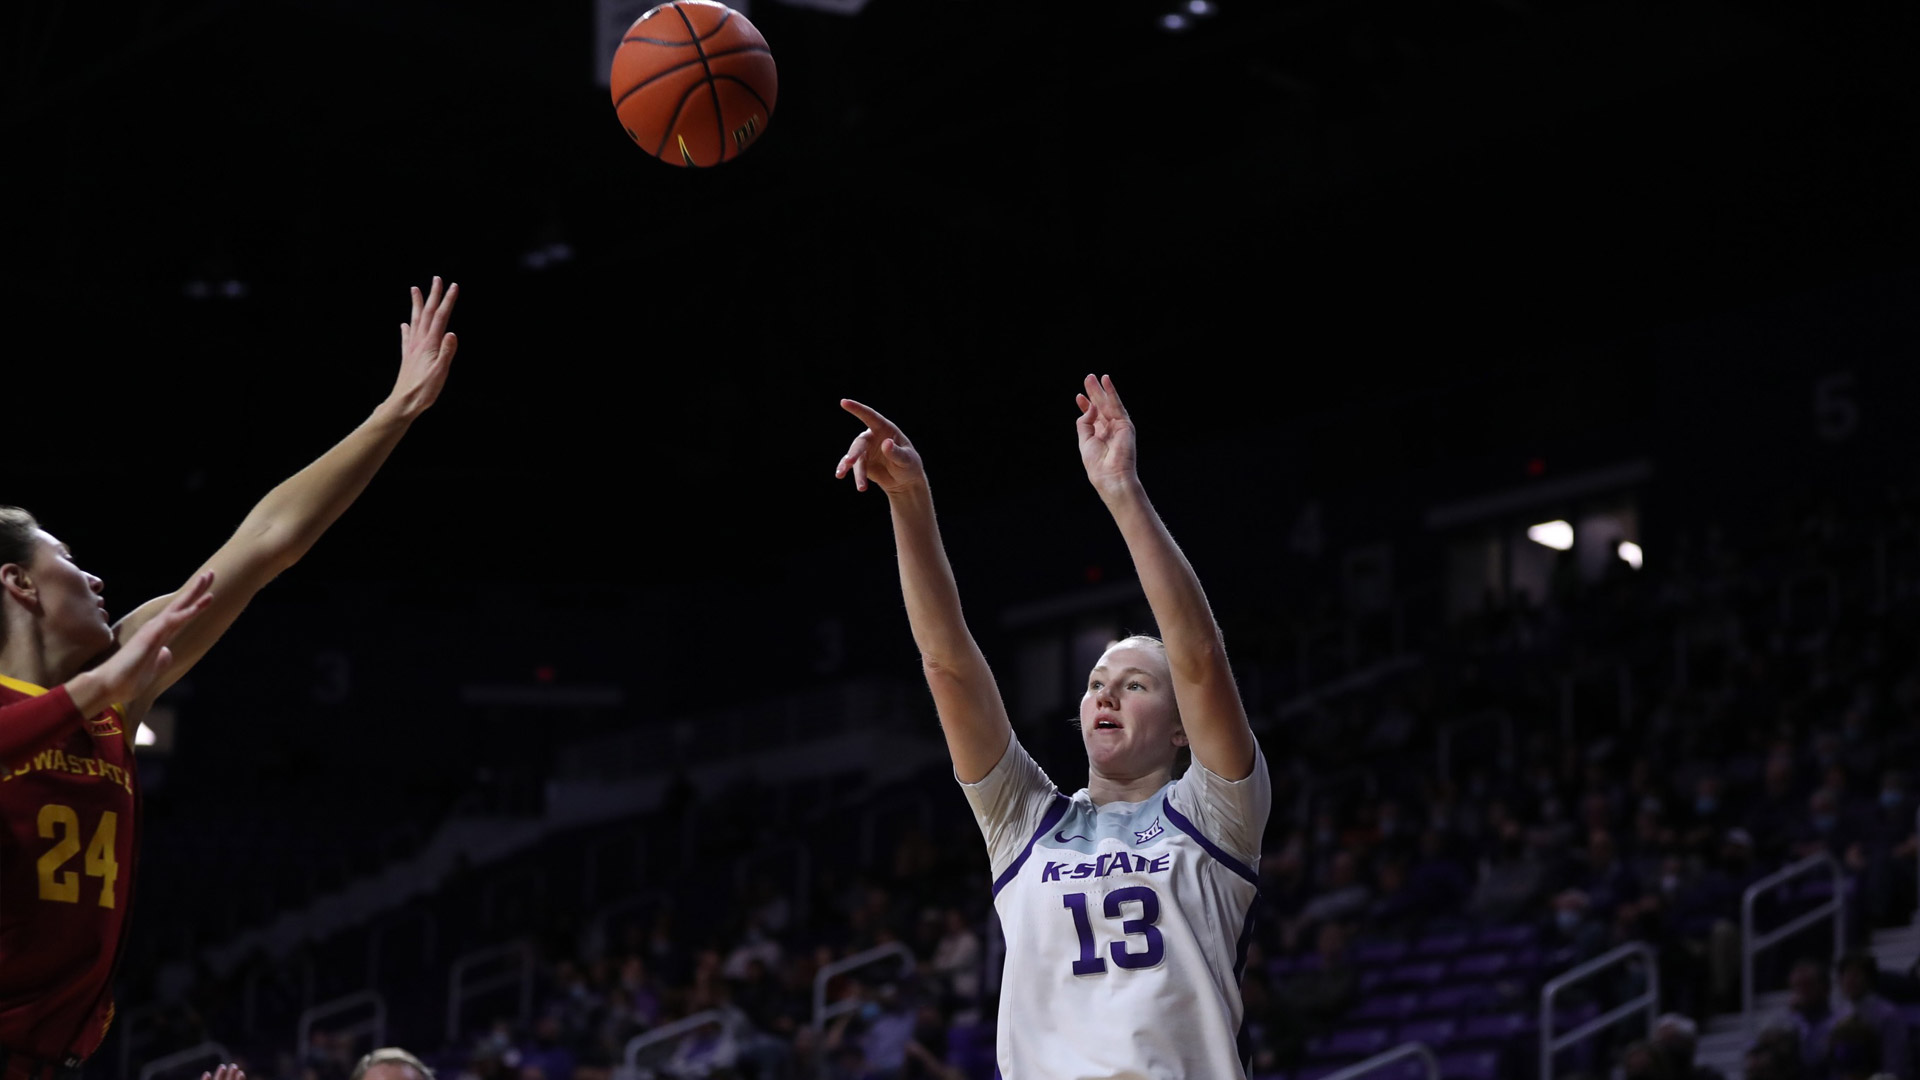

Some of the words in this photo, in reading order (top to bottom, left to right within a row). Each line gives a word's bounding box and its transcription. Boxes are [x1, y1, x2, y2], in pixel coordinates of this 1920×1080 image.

[1811, 370, 1861, 444] 5
[311, 649, 352, 704] 3
[814, 617, 846, 675] 3
[37, 804, 118, 909] 24
[1042, 852, 1170, 883] K-STATE
[1063, 886, 1165, 975] 13
